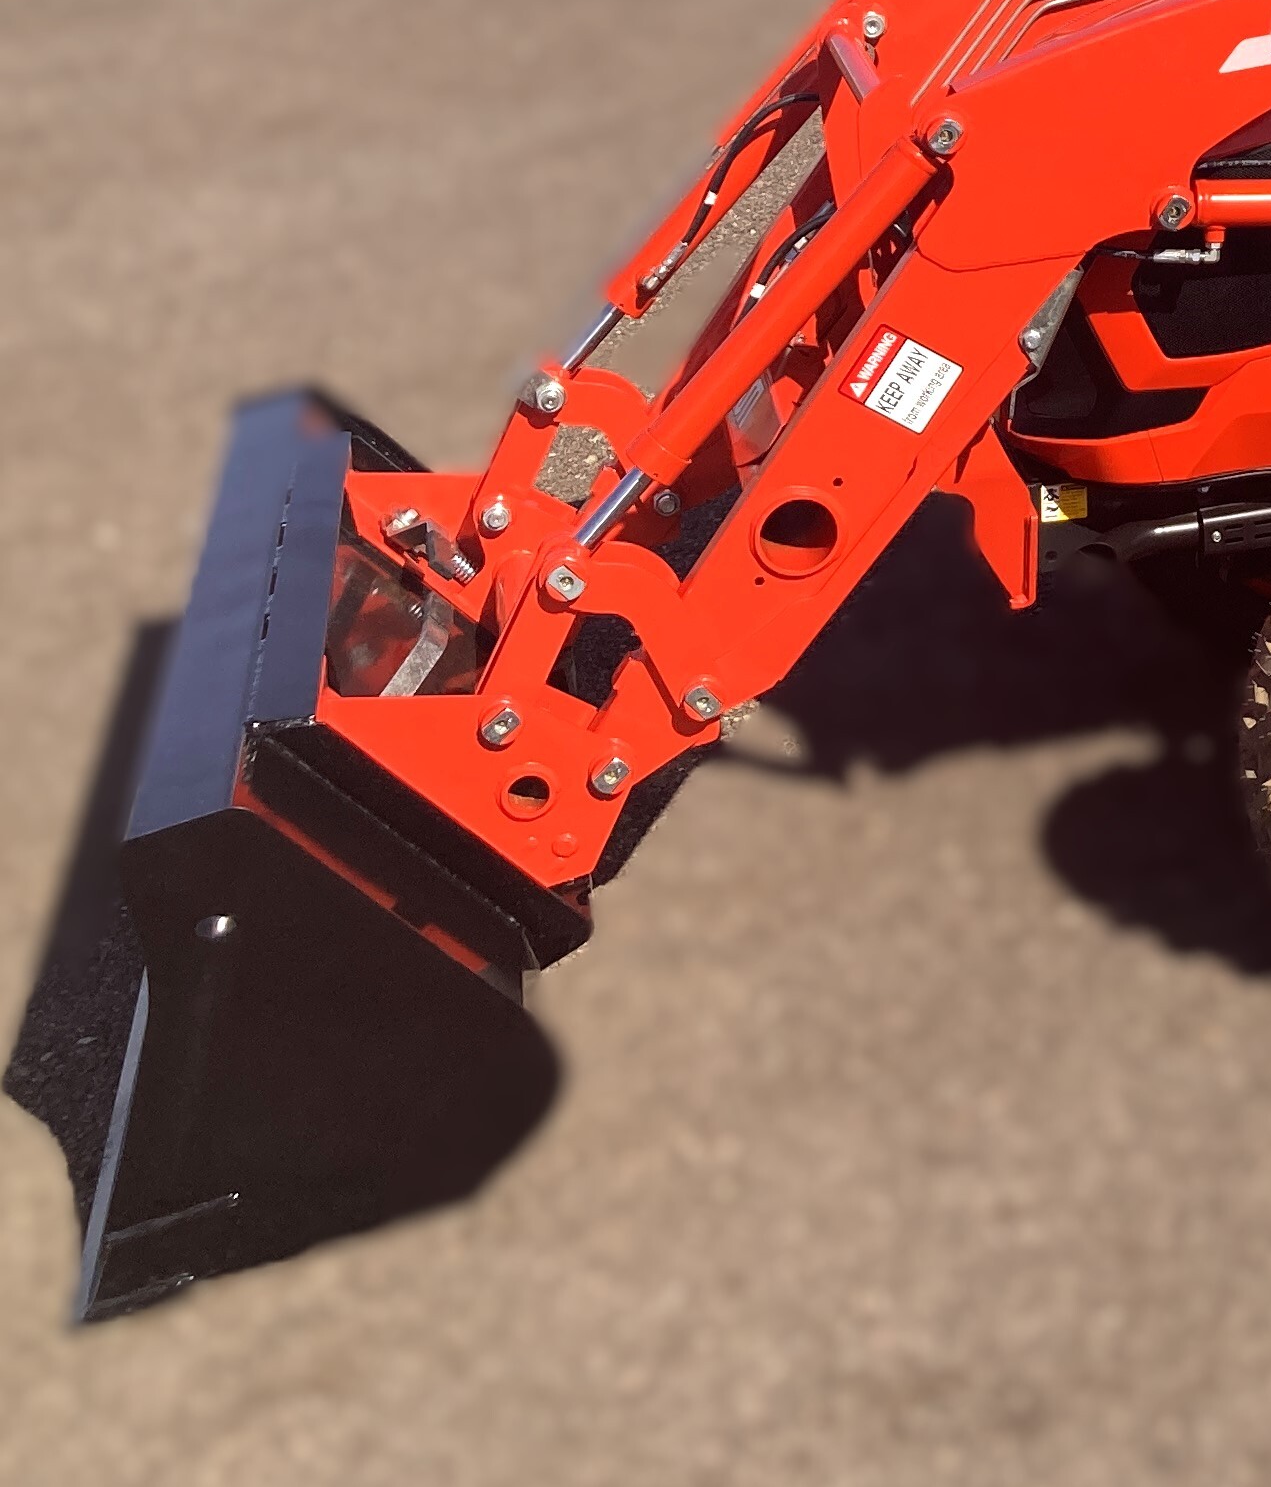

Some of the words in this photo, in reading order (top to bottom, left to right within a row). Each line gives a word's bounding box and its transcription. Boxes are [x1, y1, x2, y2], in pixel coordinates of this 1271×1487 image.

[857, 332, 898, 381] WARNING
[875, 381, 905, 414] KEEP
[896, 347, 928, 384] AWAY
[934, 362, 951, 380] area
